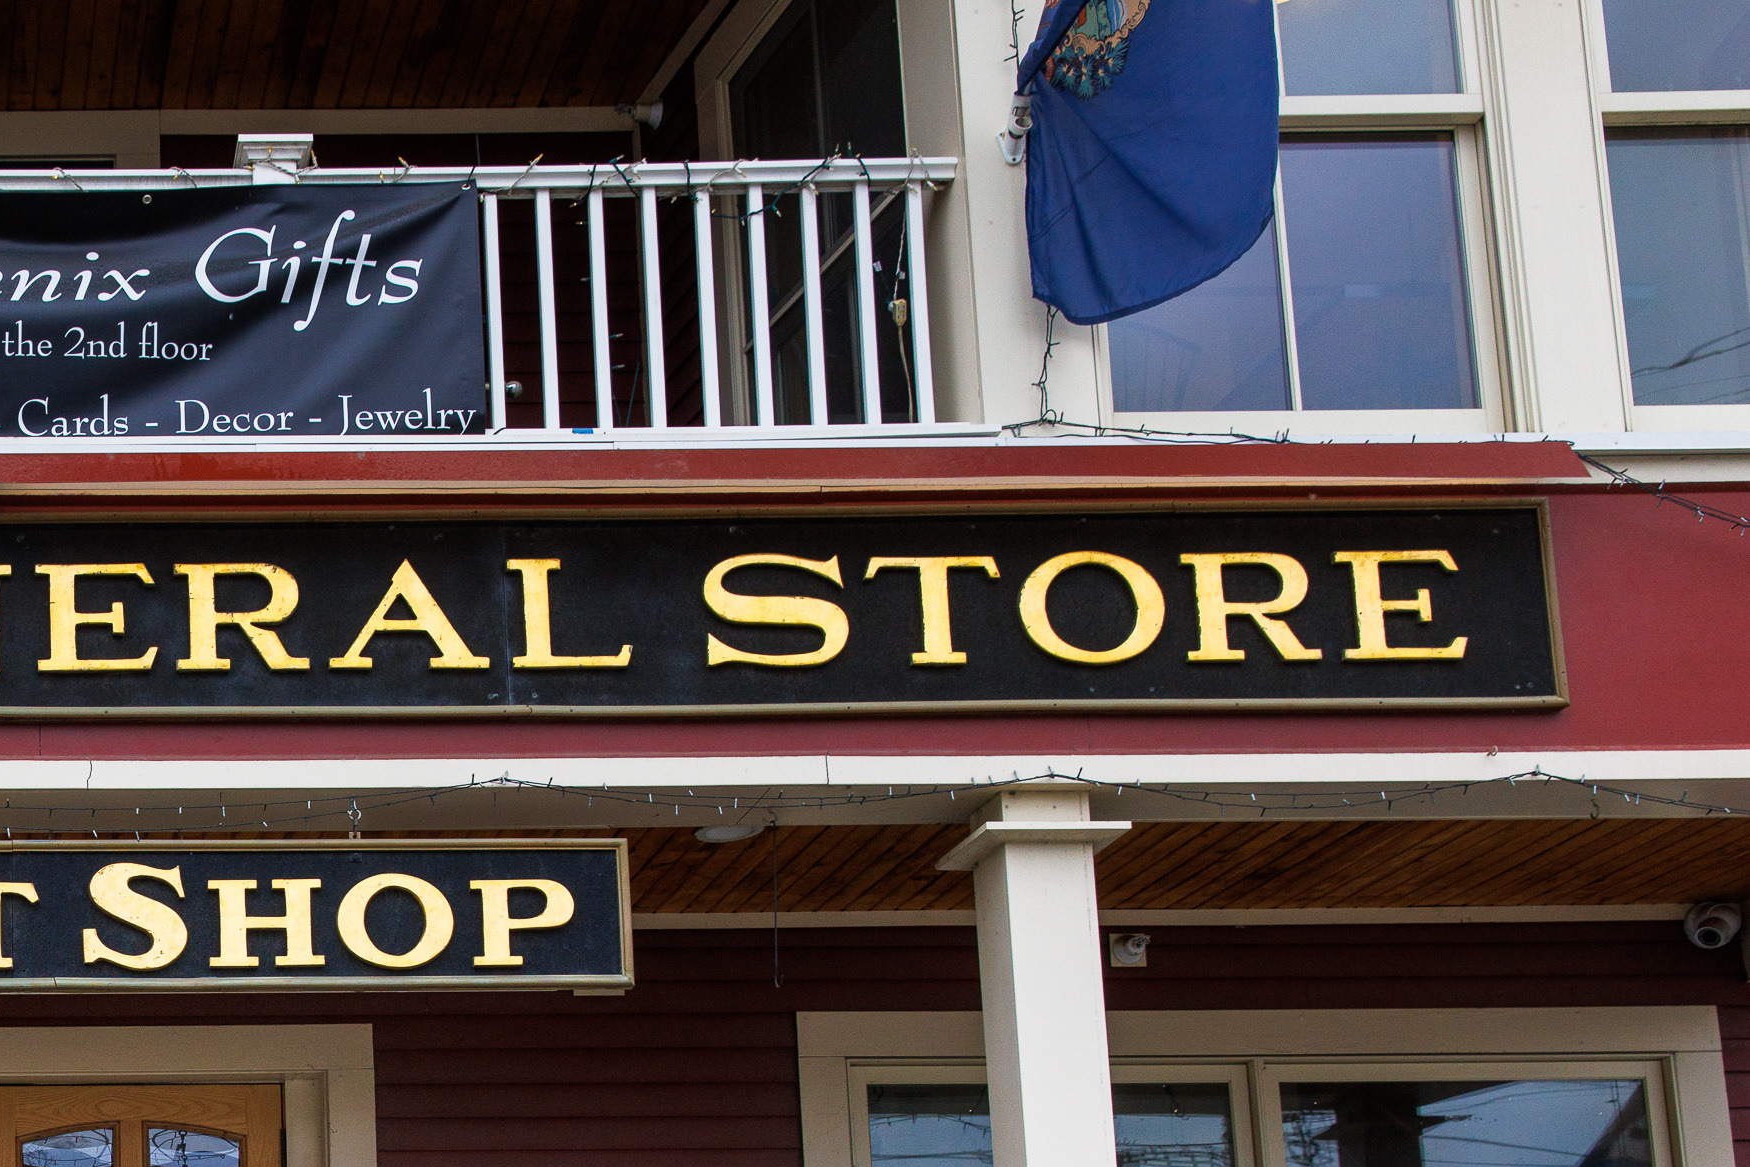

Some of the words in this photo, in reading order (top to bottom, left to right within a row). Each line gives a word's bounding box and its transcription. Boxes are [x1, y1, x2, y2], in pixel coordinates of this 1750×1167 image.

[195, 209, 422, 331] Gifts
[2, 325, 53, 360] the
[63, 325, 126, 360] 2nd
[138, 321, 213, 363] floor
[17, 396, 128, 437] Cards
[174, 400, 293, 434] Decor
[340, 390, 477, 437] Jewelry
[705, 550, 1468, 668] STORE
[83, 862, 575, 972] SHOP
